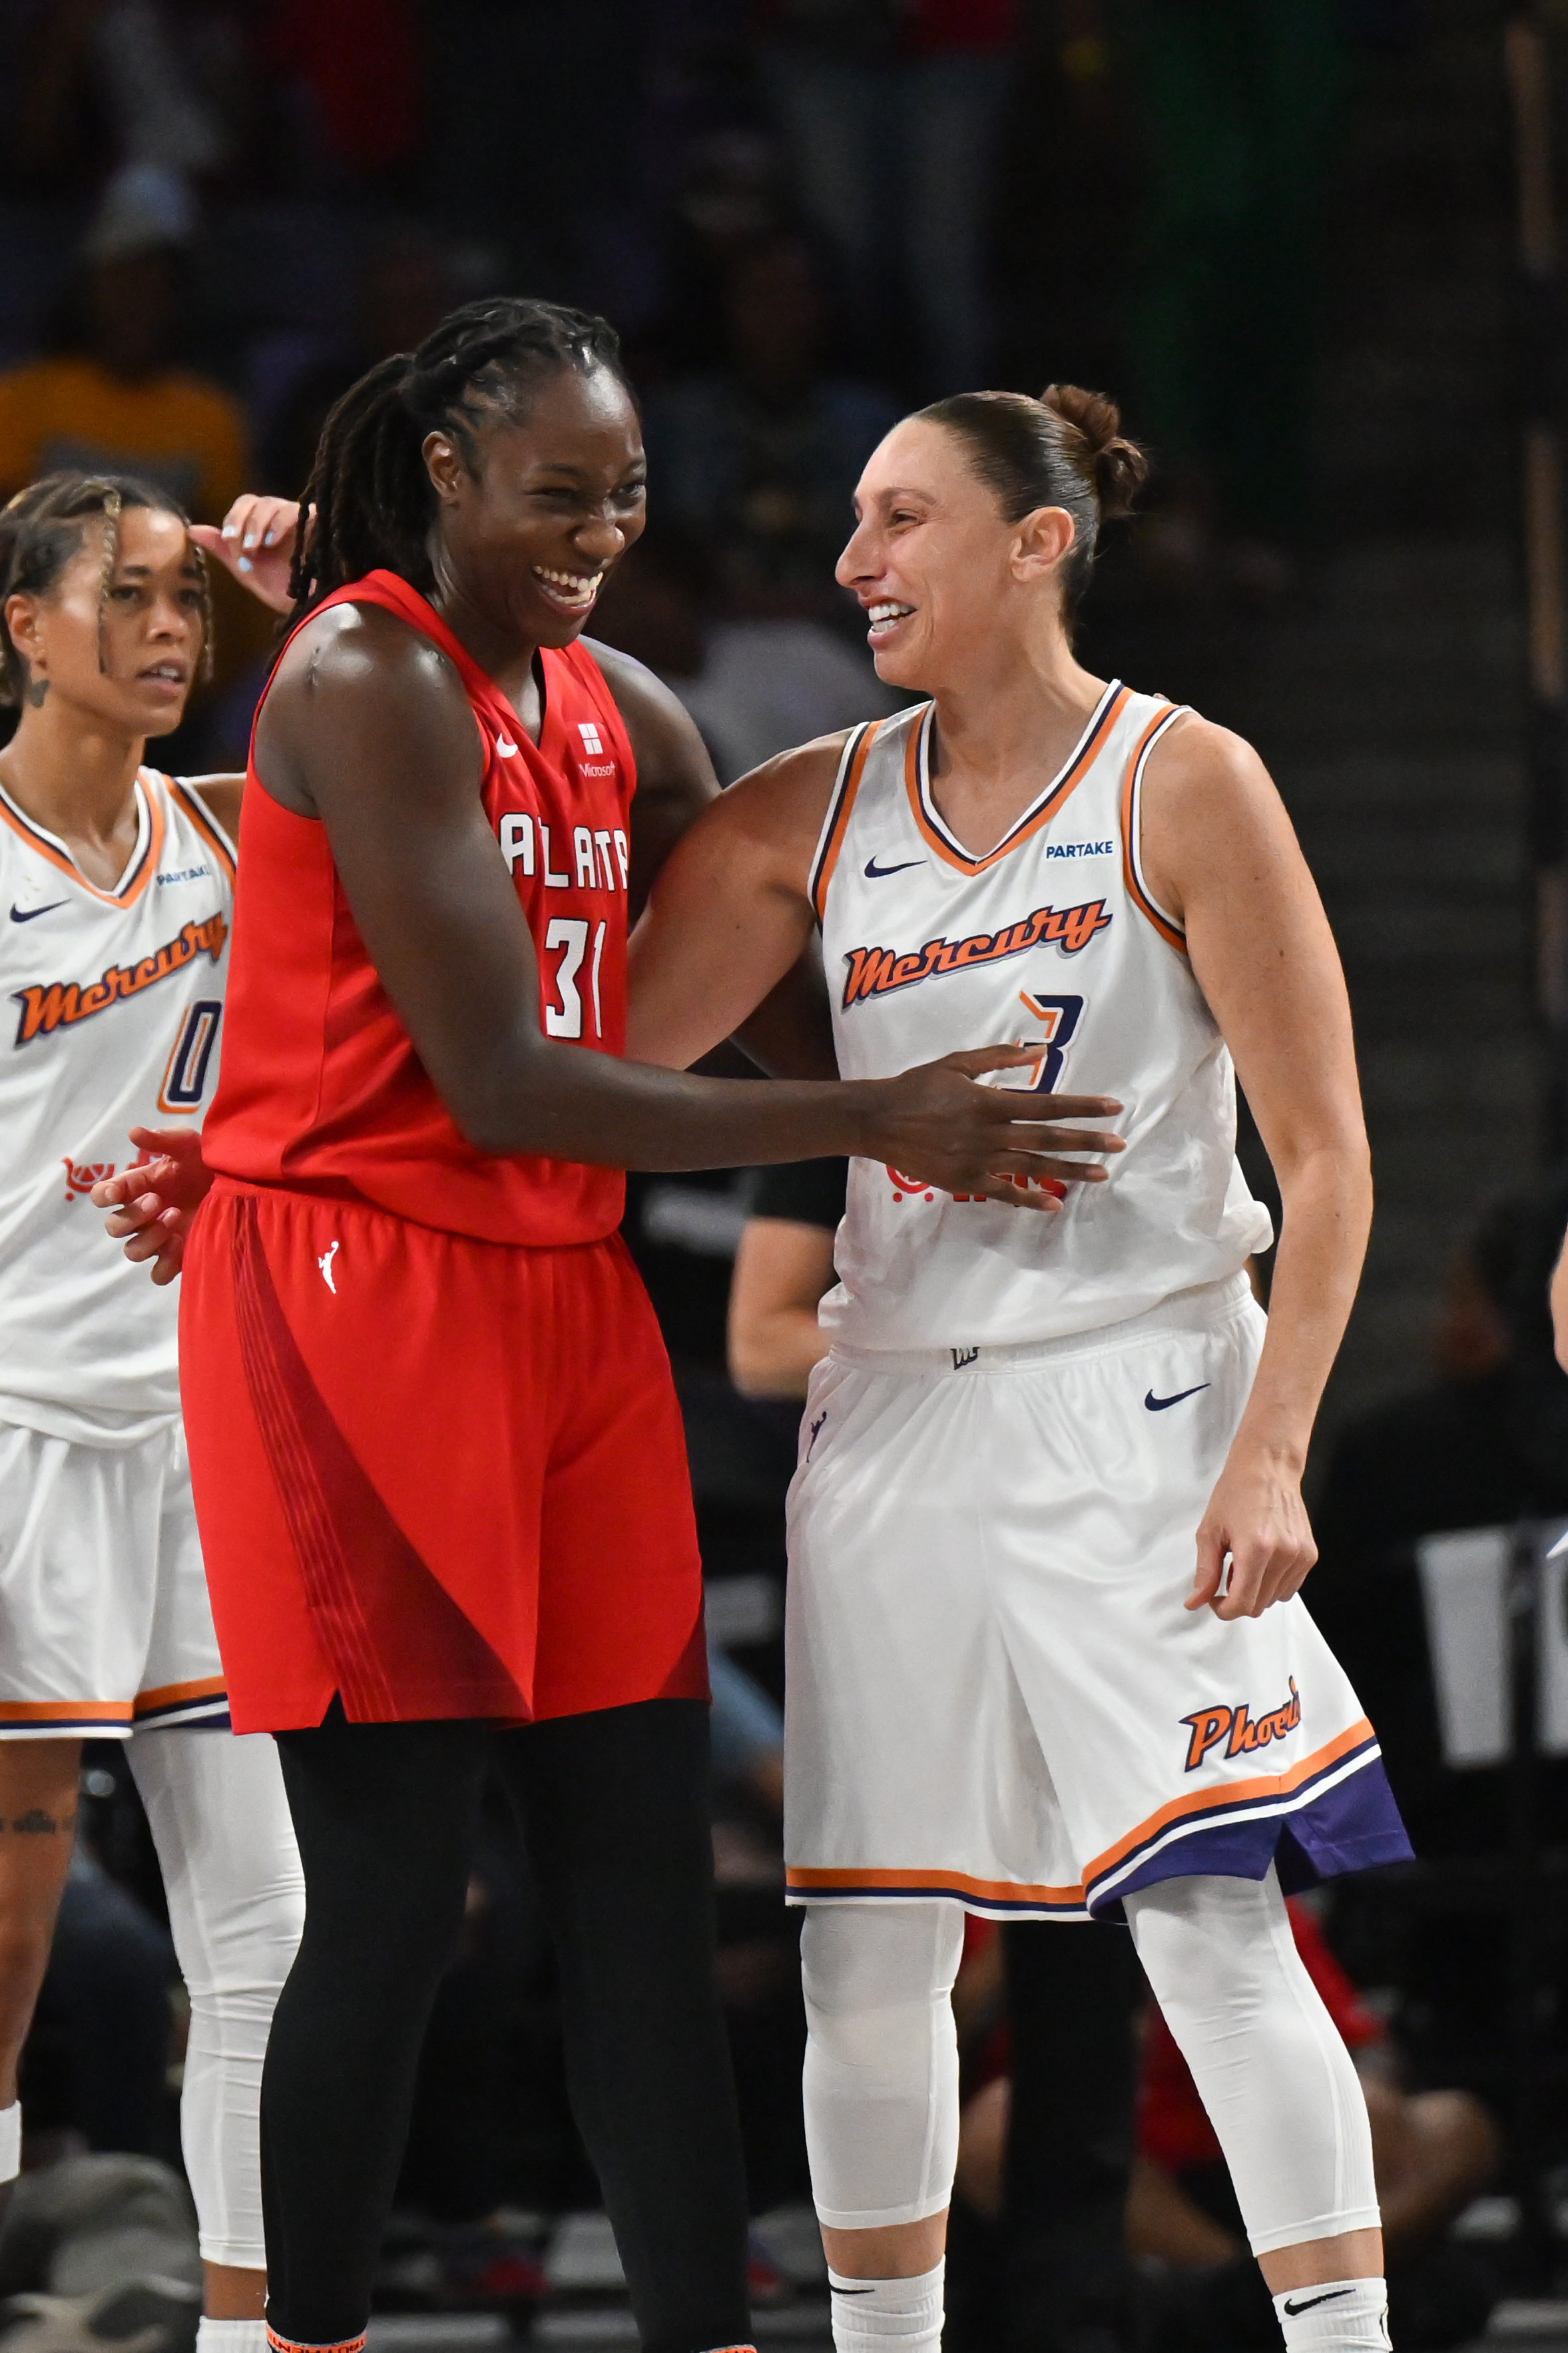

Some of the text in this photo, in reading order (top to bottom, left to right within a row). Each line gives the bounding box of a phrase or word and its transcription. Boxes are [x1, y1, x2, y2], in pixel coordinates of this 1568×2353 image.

[579, 761, 616, 778] Microsoft
[1046, 840, 1114, 858] PARTAKE
[10, 910, 228, 1050] Mercury
[545, 917, 607, 1040] 31
[841, 898, 1113, 1014] Mercury
[156, 998, 222, 1114] 0
[998, 990, 1089, 1094] 3
